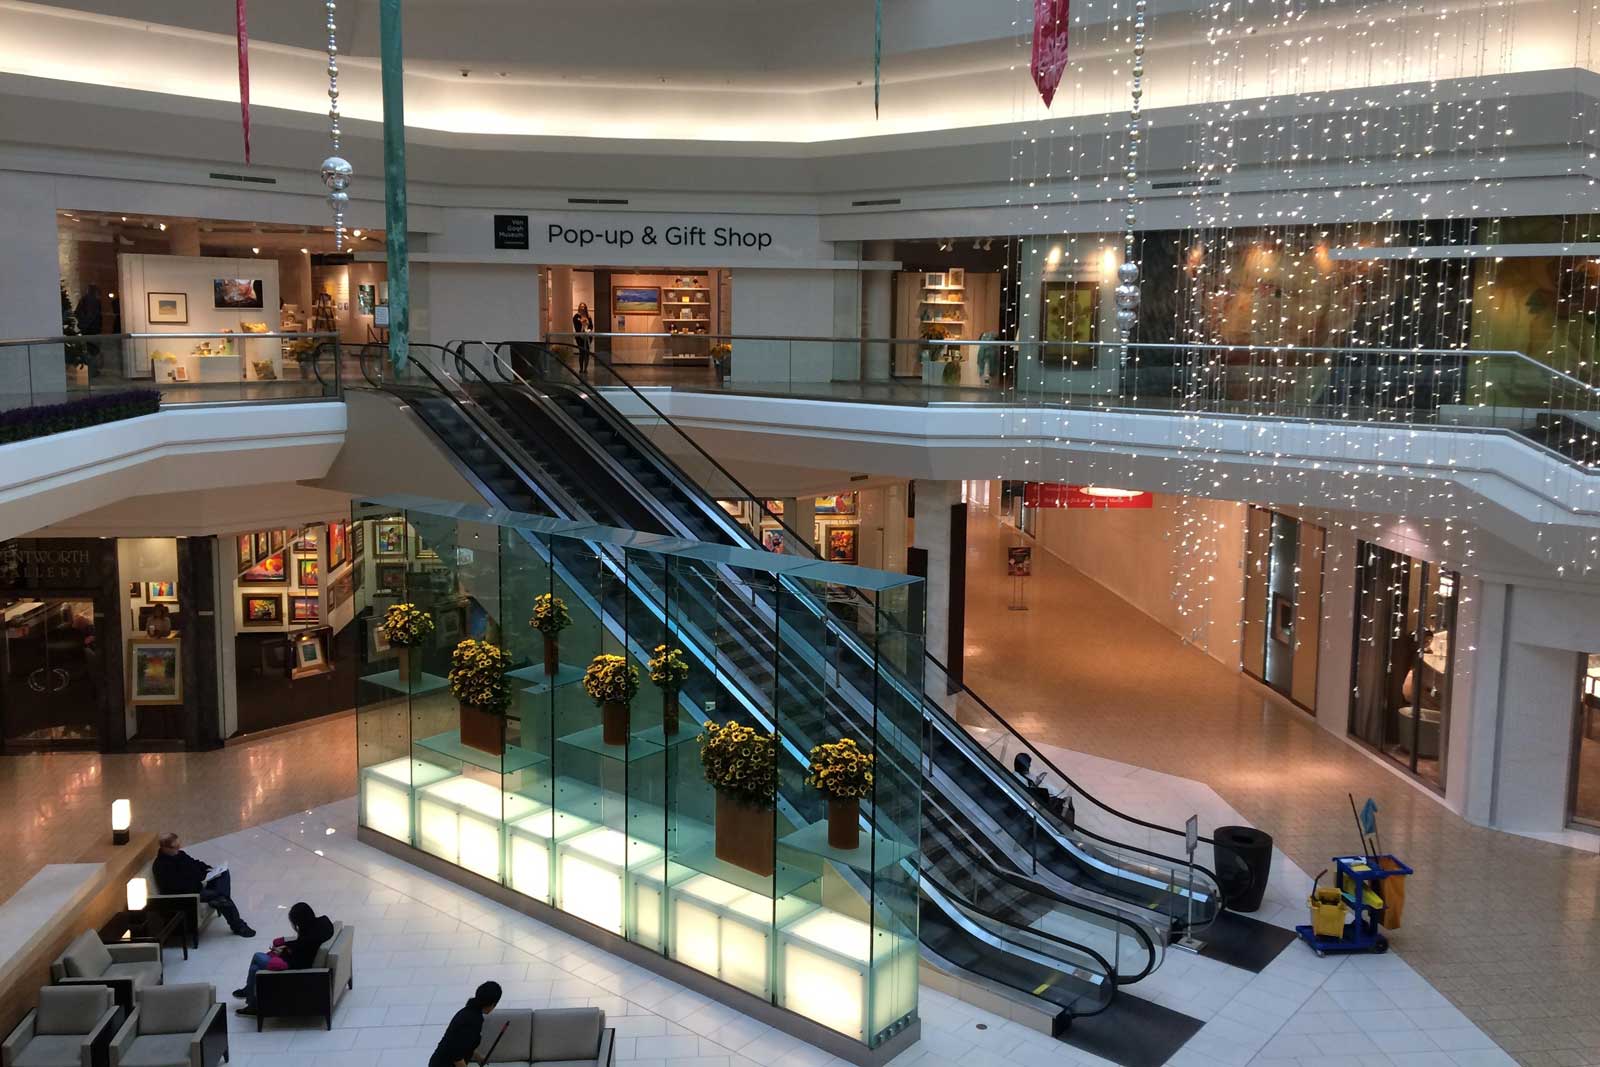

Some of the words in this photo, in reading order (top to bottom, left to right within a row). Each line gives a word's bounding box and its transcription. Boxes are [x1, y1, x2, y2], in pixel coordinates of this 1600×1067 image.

[547, 224, 634, 248] Pop-up
[641, 226, 658, 246] &
[665, 226, 707, 246] Gift
[713, 227, 773, 250] Shop
[0, 550, 89, 563] ENTWORTH
